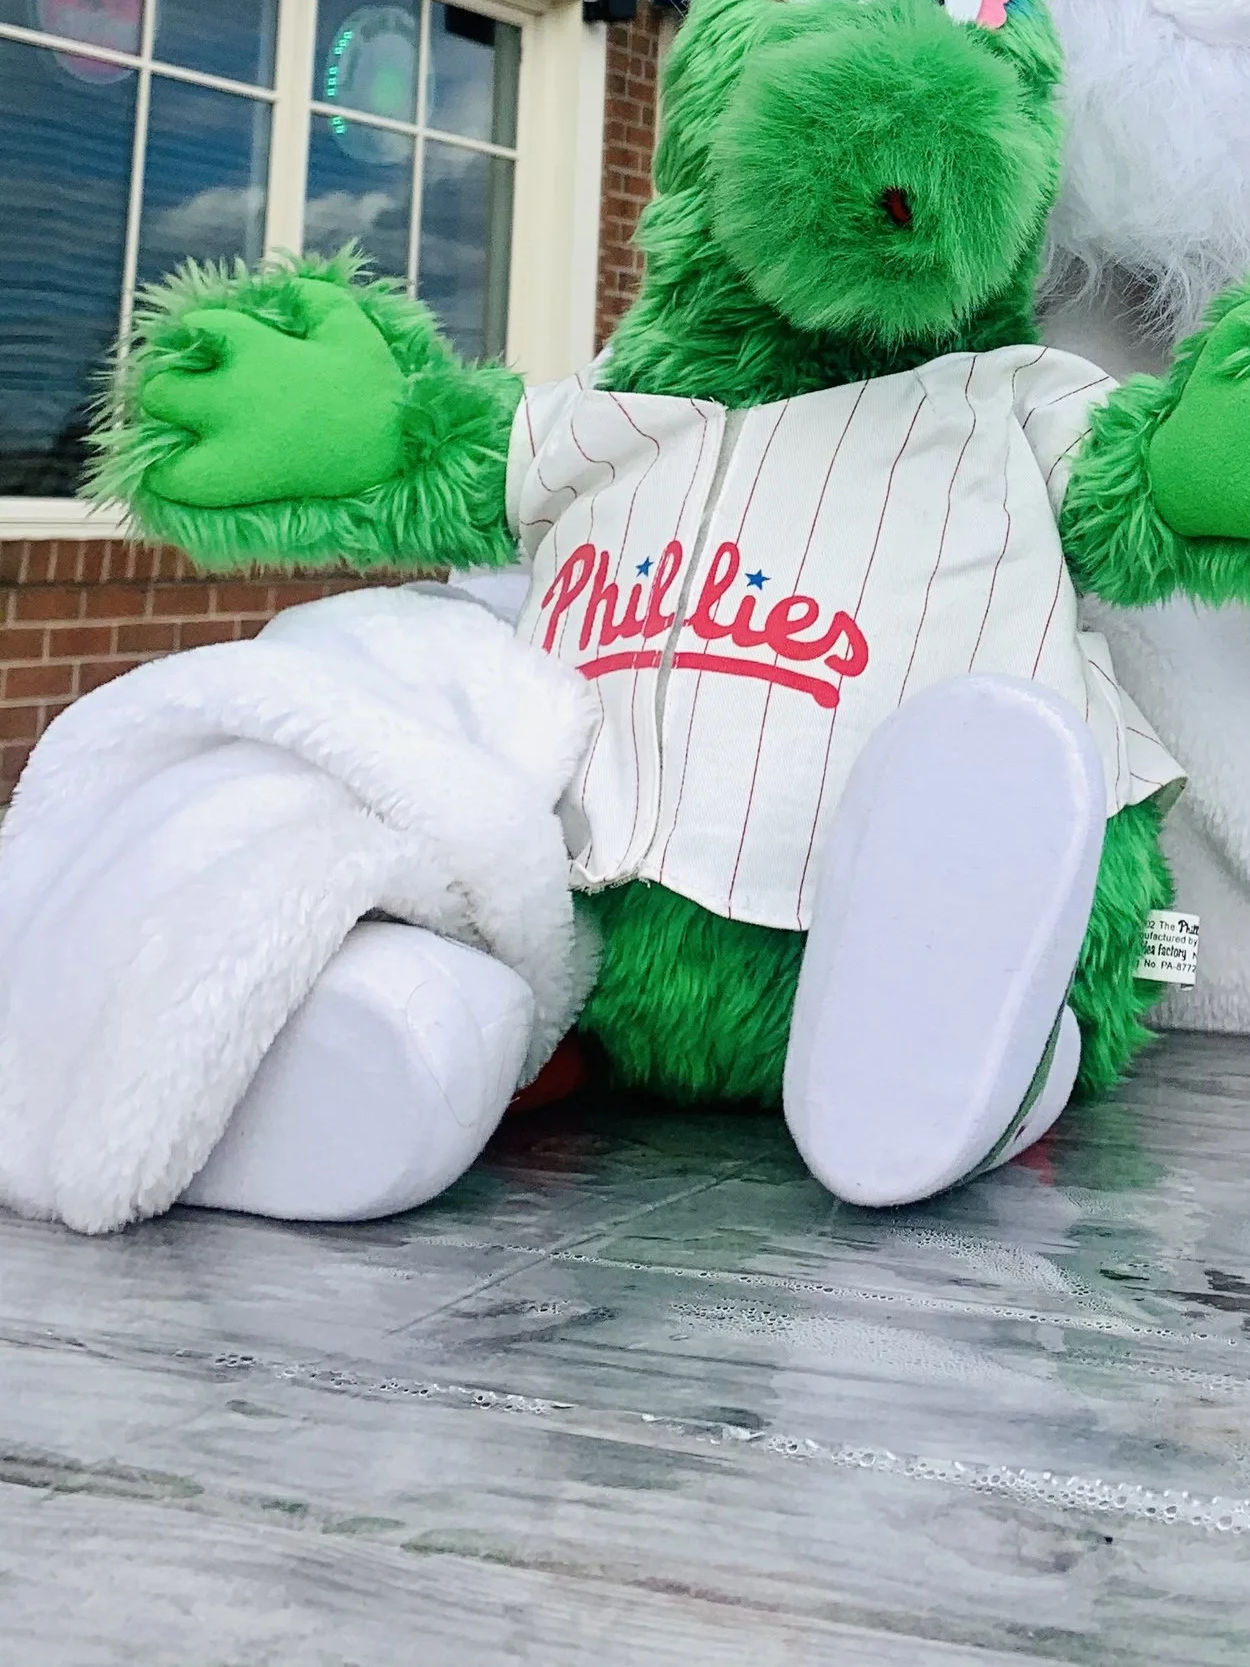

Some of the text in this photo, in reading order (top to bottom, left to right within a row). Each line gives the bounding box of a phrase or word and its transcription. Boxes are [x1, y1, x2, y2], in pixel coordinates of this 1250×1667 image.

[541, 540, 869, 677] Phillies
[1160, 920, 1175, 932] The
[1189, 936, 1198, 947] by
[1158, 943, 1187, 961] factory
